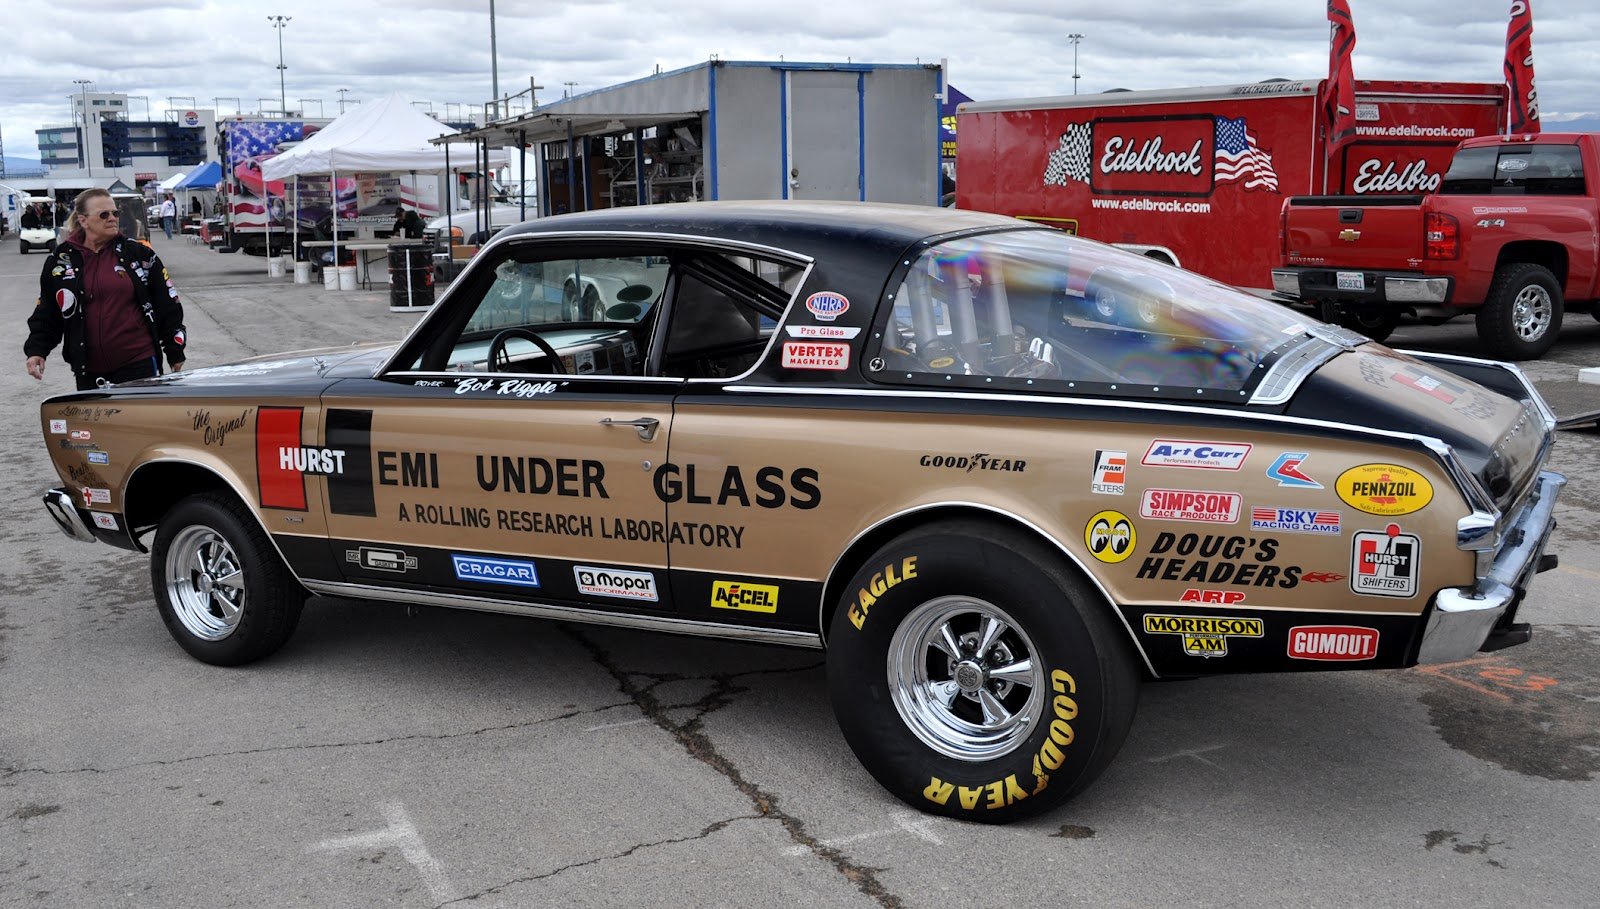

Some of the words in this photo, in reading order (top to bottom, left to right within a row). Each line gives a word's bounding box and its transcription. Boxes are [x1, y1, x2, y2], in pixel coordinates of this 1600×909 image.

[1355, 125, 1475, 137] www.edelbrock.com
[1100, 136, 1202, 176] Edelbrock
[1353, 158, 1440, 194] Edelbro
[1092, 198, 1211, 213] www.edelbrock.com
[813, 296, 843, 311] NHRA
[801, 327, 816, 336] Pro
[819, 328, 845, 336] Glass
[788, 345, 844, 358] VERTEX
[789, 358, 840, 366] MAGNETOS
[279, 446, 346, 475] HURST
[1099, 464, 1122, 472] FRAM
[1388, 467, 1409, 477] Quality
[475, 454, 611, 500] UNDER
[652, 462, 822, 510] GLASS
[1092, 483, 1124, 494] FILTERS
[1352, 481, 1417, 497] PENNZOIL
[1149, 491, 1233, 514] SIMPSON
[1360, 503, 1372, 511] Safe
[1372, 505, 1406, 514] Lubrication
[1151, 509, 1175, 518] RACE
[1180, 511, 1229, 521] PRODUCTS
[1277, 509, 1317, 524] ISKY
[398, 502, 412, 522] A
[415, 503, 491, 529] ROLLING
[497, 509, 594, 538] RESEARCH
[600, 516, 746, 549] LABORATORY
[1096, 527, 1127, 537] MOON
[1252, 520, 1300, 531] RACING
[1302, 523, 1340, 533] CAMS
[1149, 531, 1279, 562] DOUG'S
[1364, 552, 1408, 566] HURST
[458, 561, 532, 580] CRAGAR
[1136, 557, 1303, 589] HEADERS
[597, 572, 652, 591] Mopar
[1362, 577, 1406, 589] SHIFTERS
[580, 585, 656, 598] PERFORMANCE
[715, 584, 774, 608] ACCEL
[847, 555, 918, 631] EAGLE
[1180, 589, 1246, 604] ARP
[1148, 617, 1259, 634] MORRISON
[1188, 640, 1223, 650] AM
[1294, 632, 1373, 657] GUMOUT
